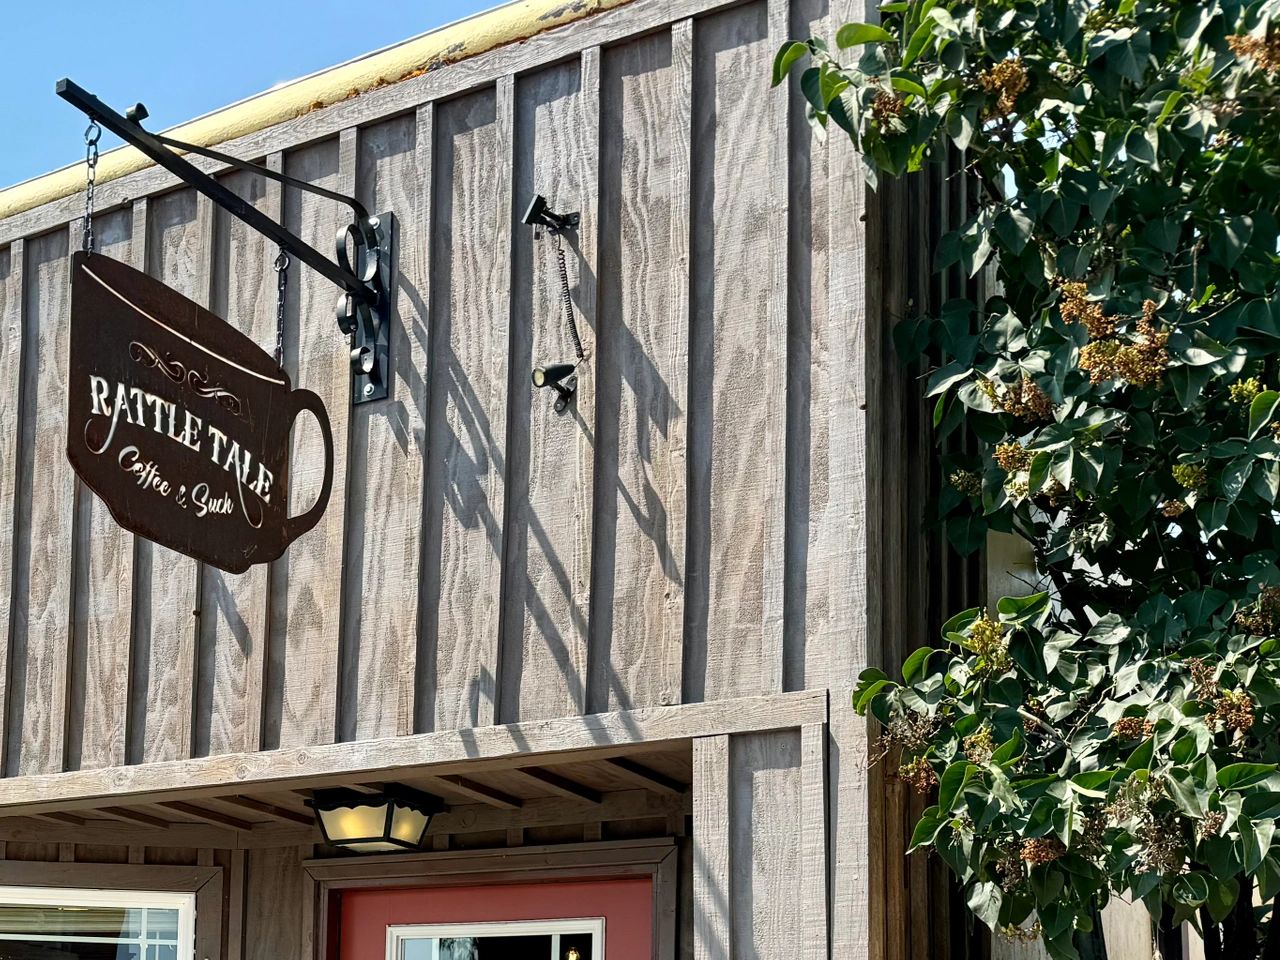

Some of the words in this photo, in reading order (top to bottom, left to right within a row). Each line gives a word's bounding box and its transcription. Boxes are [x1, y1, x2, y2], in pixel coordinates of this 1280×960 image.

[85, 374, 202, 454] RATTLE
[208, 425, 274, 528] TALE
[118, 446, 171, 497] Coffee
[175, 485, 187, 509] &
[192, 483, 234, 517] Such
